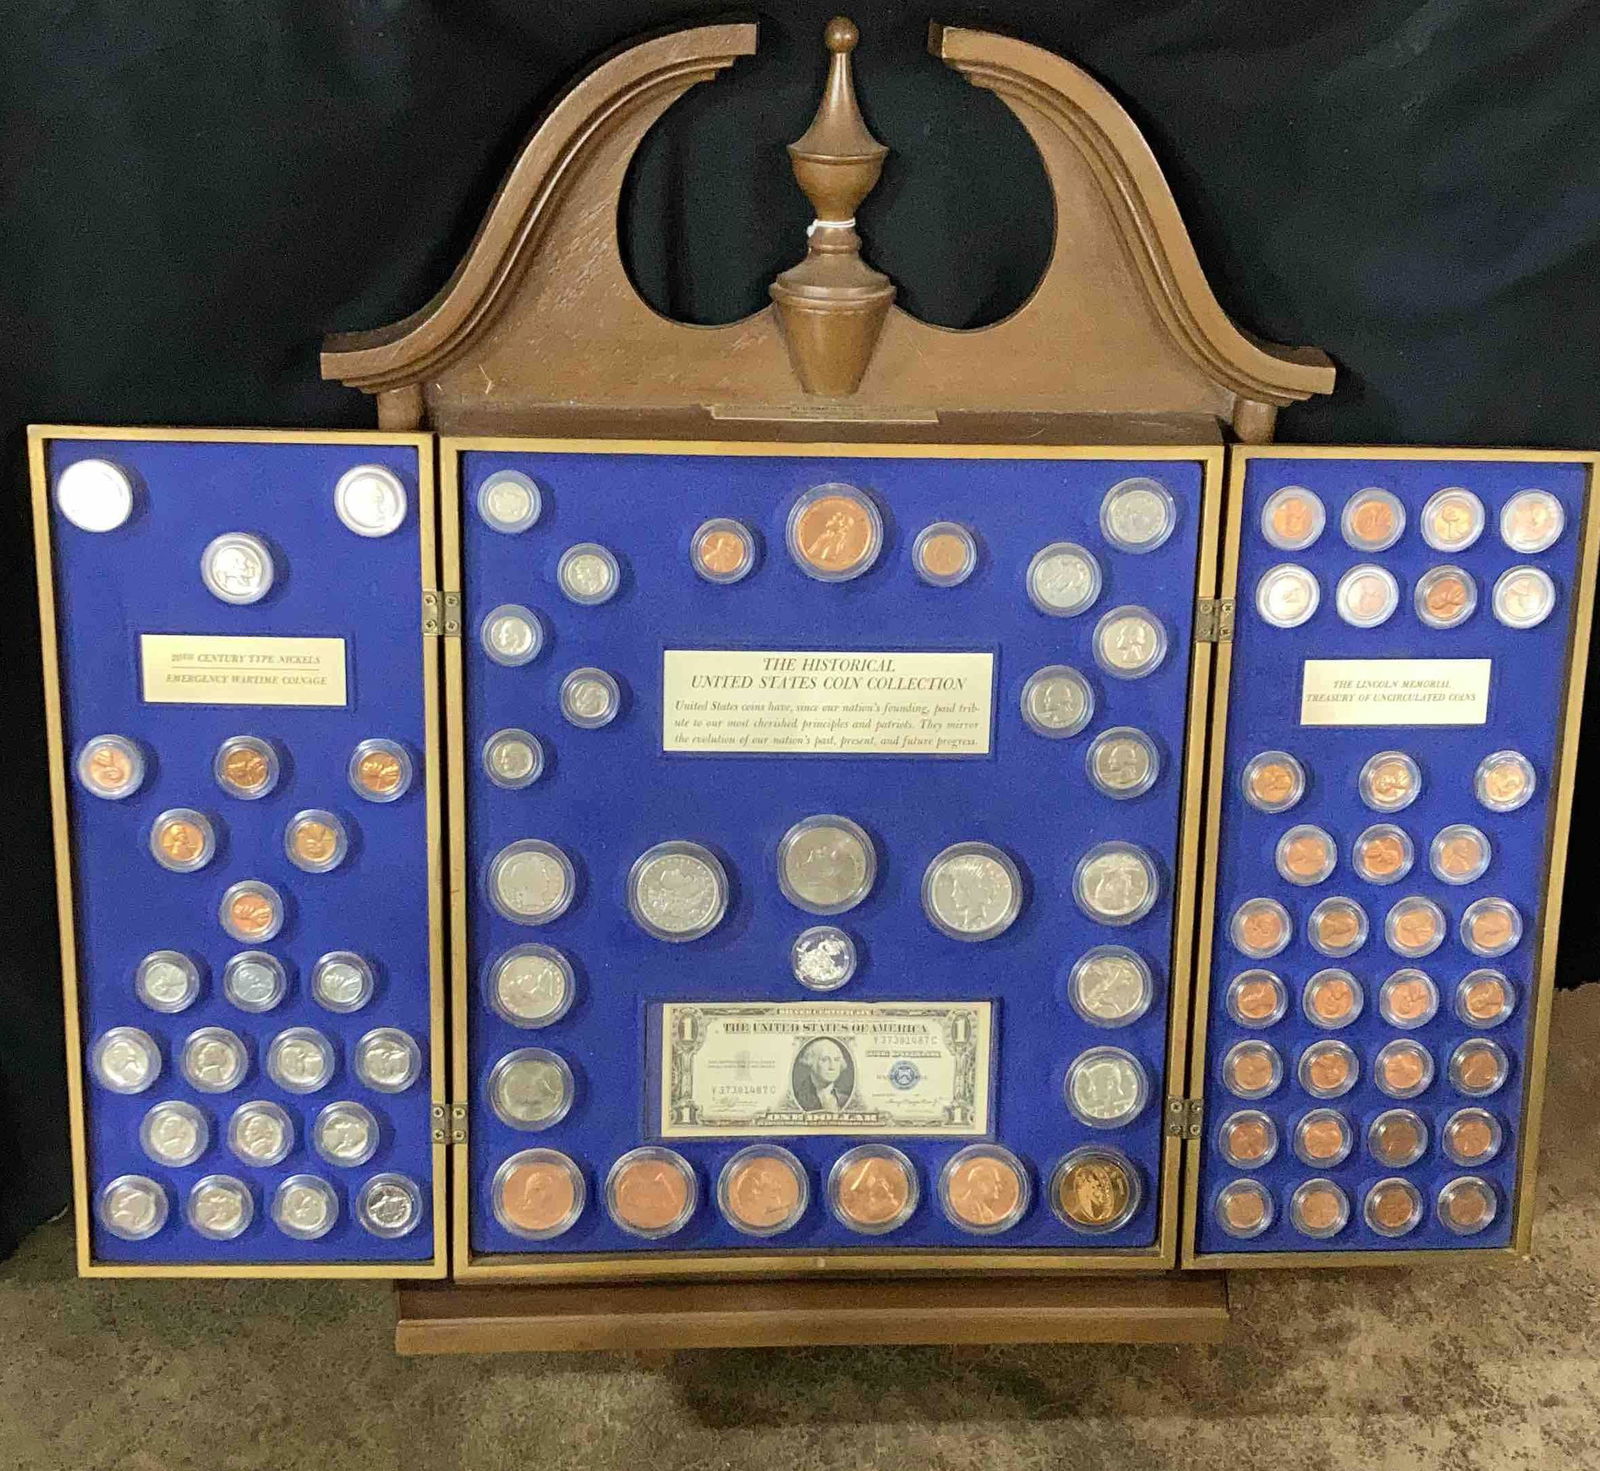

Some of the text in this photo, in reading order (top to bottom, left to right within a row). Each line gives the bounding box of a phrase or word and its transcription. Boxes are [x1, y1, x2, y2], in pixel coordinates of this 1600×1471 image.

[198, 654, 244, 663] CENTURY
[248, 654, 274, 664] TYPE
[277, 655, 321, 665] NICKELS
[763, 658, 896, 672] THE HISTORICAL
[166, 674, 328, 685] EMERGENCY WARTIME COINAGE
[691, 675, 968, 690] UNITED STATES COIN COLLECTION
[1332, 680, 1452, 689] THE LINCOLN MEMORIAL
[1306, 693, 1477, 702] TREASURY OF UNCIRCULATED COINS
[675, 700, 708, 711] United
[710, 700, 738, 711] States
[741, 702, 765, 711] coins
[768, 701, 793, 713] have,
[796, 703, 818, 712] since
[842, 702, 881, 712] nation's
[882, 702, 931, 715] founding,
[933, 703, 957, 715] paid
[958, 703, 981, 712] trib-
[674, 718, 980, 731] ute to our most cherished principles and patriots. They mirror
[675, 733, 978, 748] the evolution of our nation's past, present, and future progress.
[723, 1023, 928, 1034] THE UNITED STATES OF AMERICA
[768, 1112, 878, 1121] ONE DOLLAR
